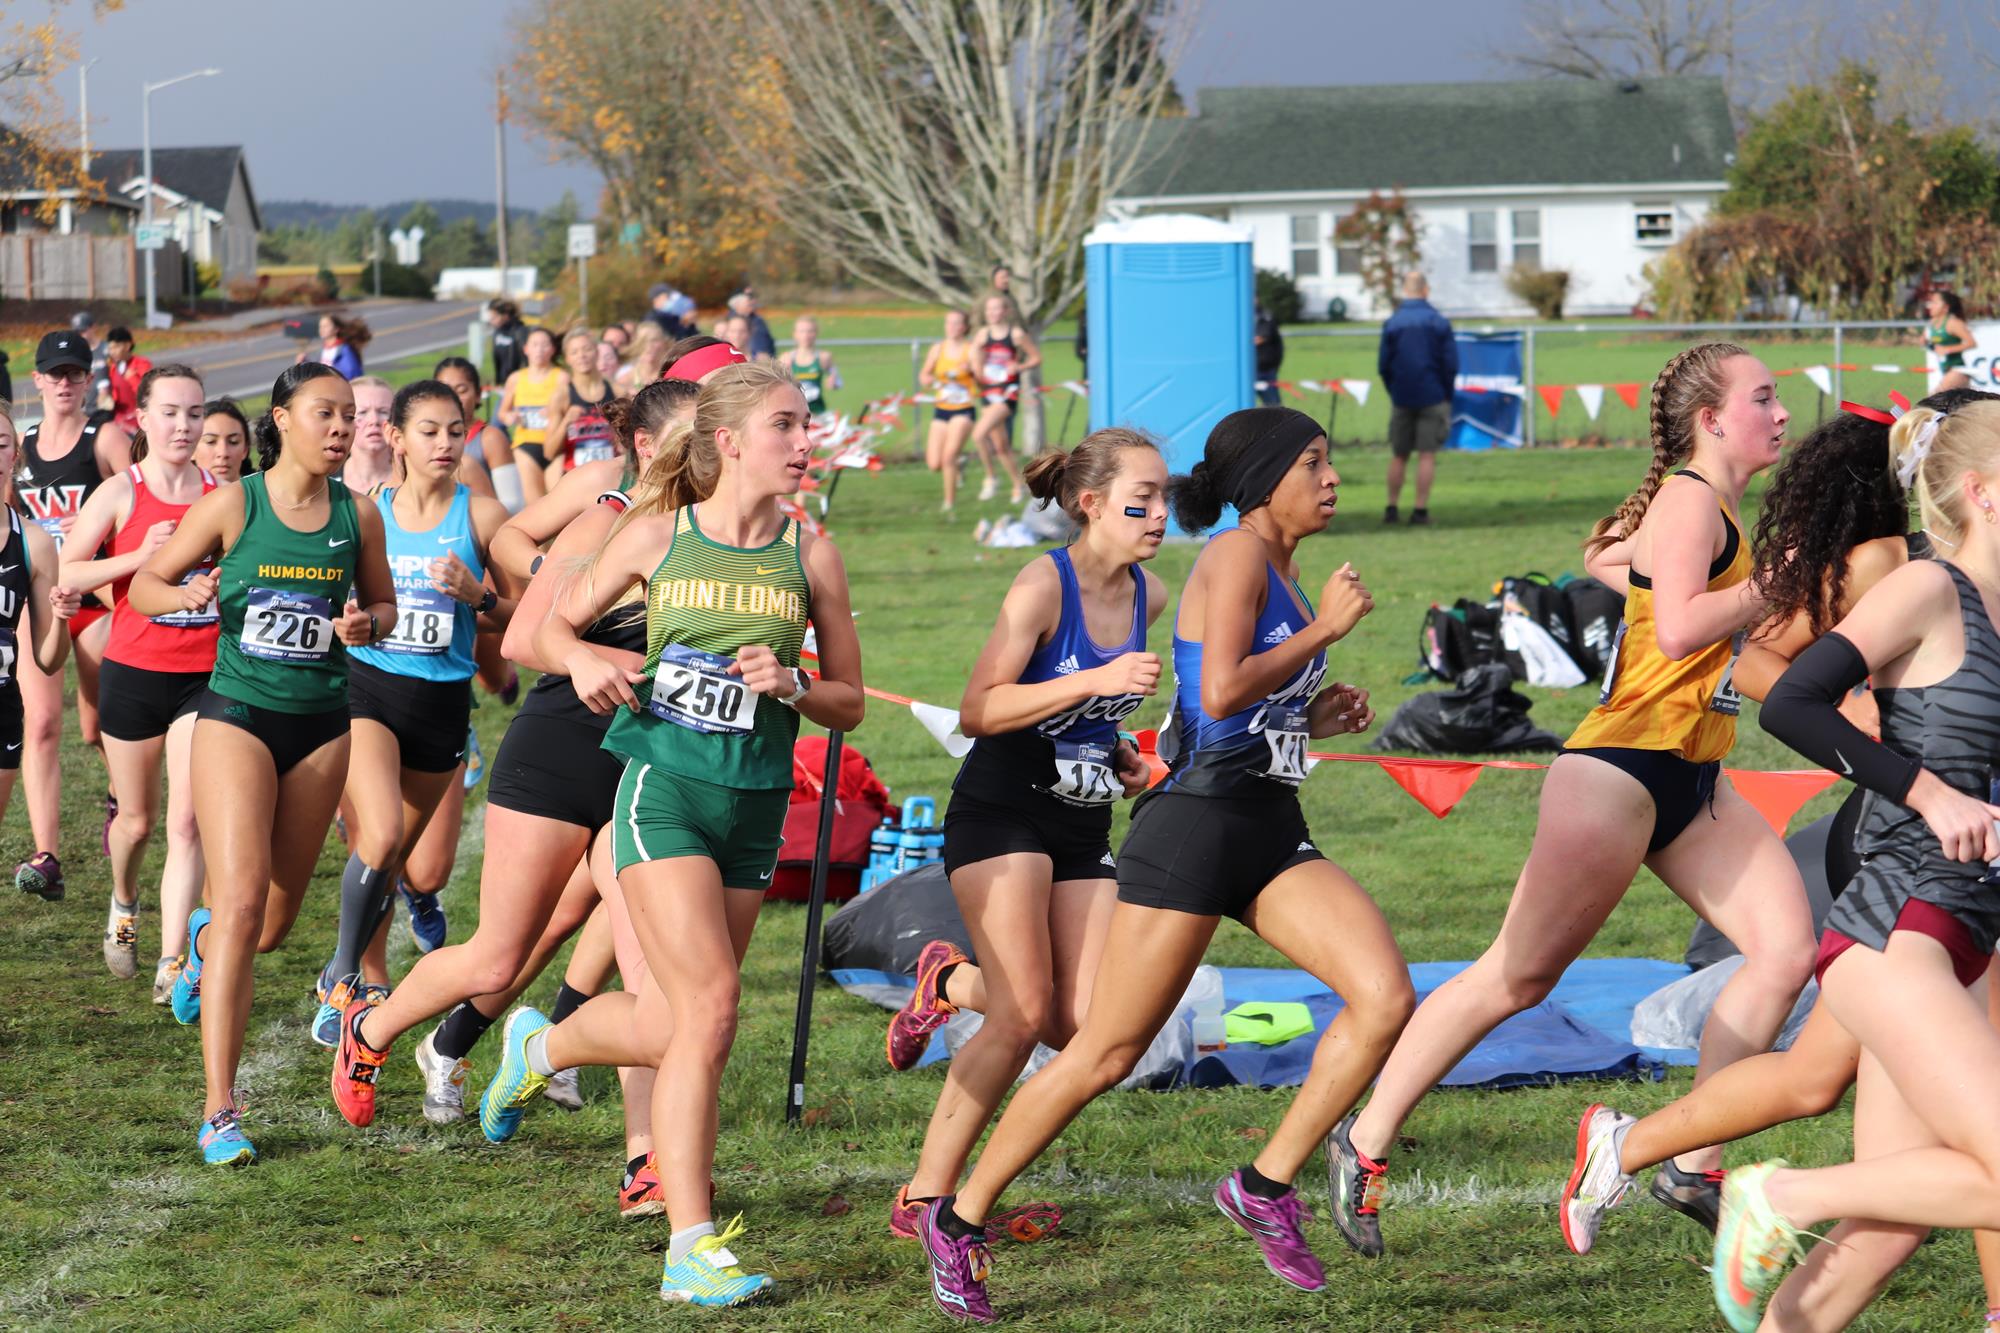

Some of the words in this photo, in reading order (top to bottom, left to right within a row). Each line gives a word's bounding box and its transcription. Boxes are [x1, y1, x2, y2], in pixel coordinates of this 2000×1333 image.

[258, 565, 343, 581] HUMBOLDT
[394, 577, 434, 589] HARK
[659, 579, 731, 611] POINT
[734, 584, 799, 623] LOMA
[255, 611, 321, 650] 226
[386, 611, 440, 645] 18
[667, 669, 744, 723] 250
[1276, 733, 1308, 777] 170
[1066, 763, 1113, 799] 171
